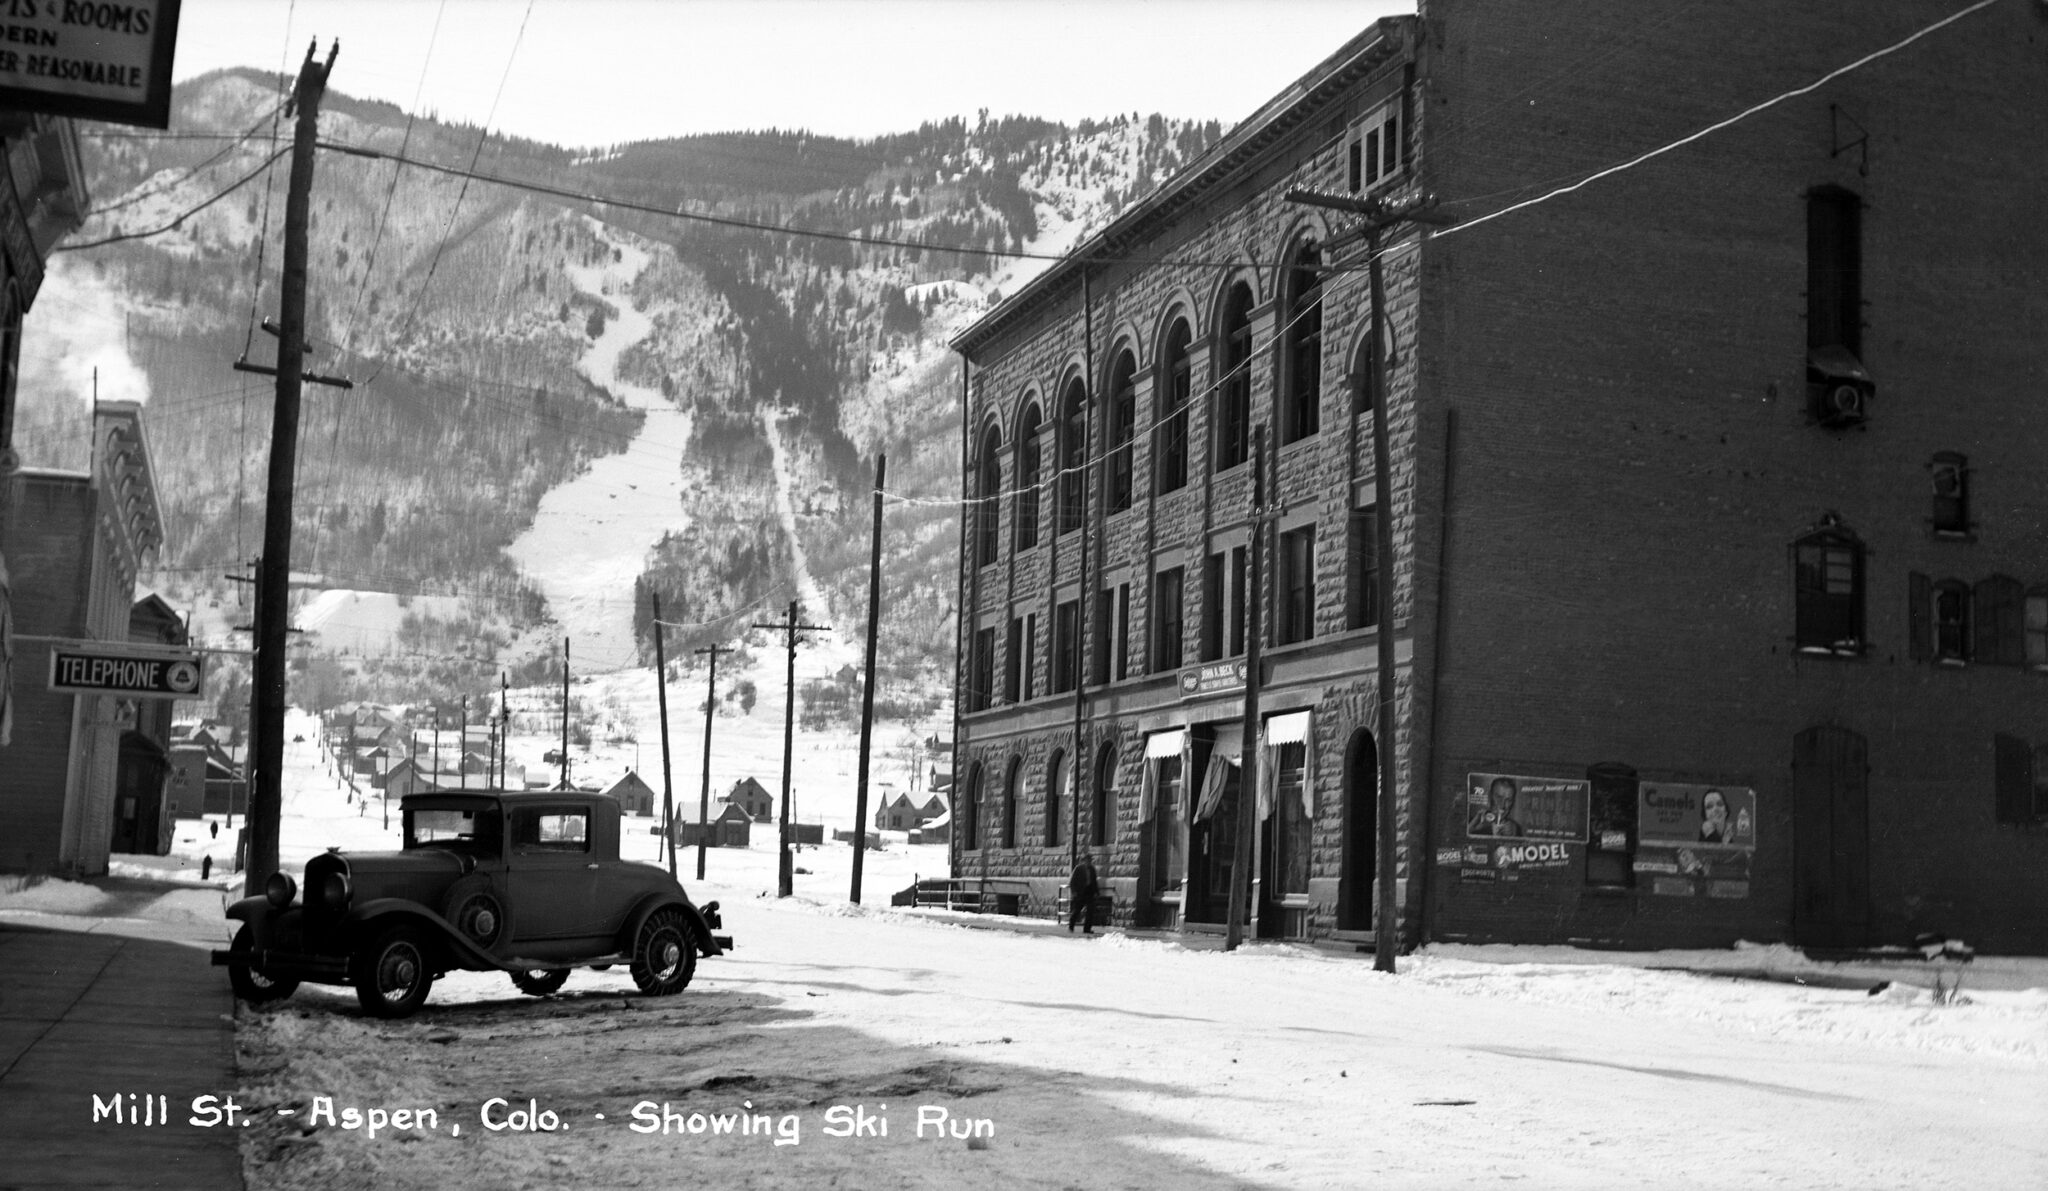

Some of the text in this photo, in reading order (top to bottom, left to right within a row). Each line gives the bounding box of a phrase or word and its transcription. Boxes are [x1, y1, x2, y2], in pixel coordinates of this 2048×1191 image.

[62, 0, 151, 34] ROOMS
[26, 54, 141, 87] REASONABLE
[60, 657, 159, 688] TELEPHONE
[1511, 843, 1569, 863] MODEL
